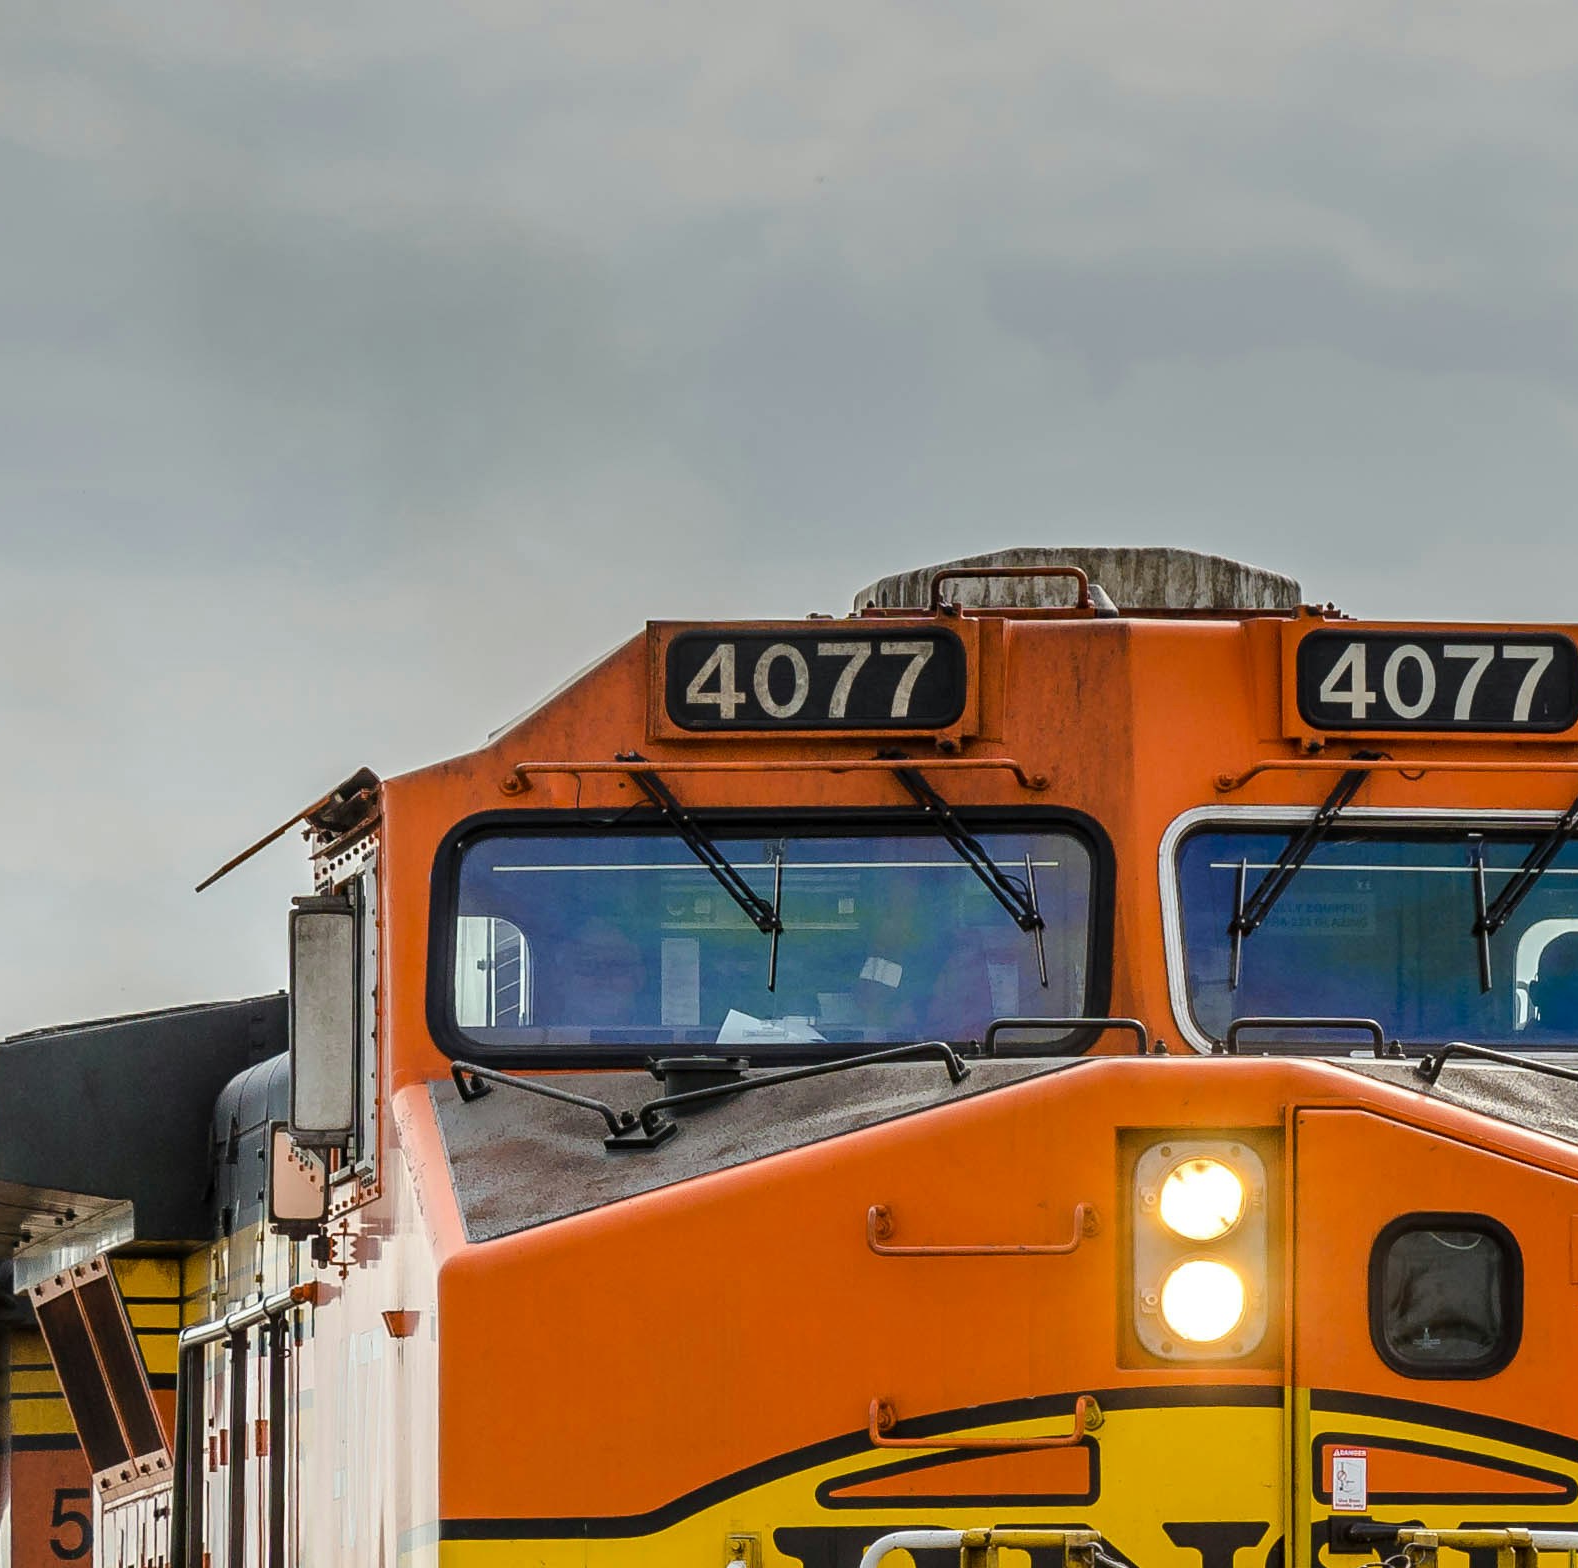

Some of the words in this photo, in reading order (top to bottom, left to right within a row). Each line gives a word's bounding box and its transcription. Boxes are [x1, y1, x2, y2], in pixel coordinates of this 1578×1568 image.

[685, 641, 934, 719] 4077
[1318, 644, 1555, 722] 4077
[50, 1488, 93, 1560] 5
